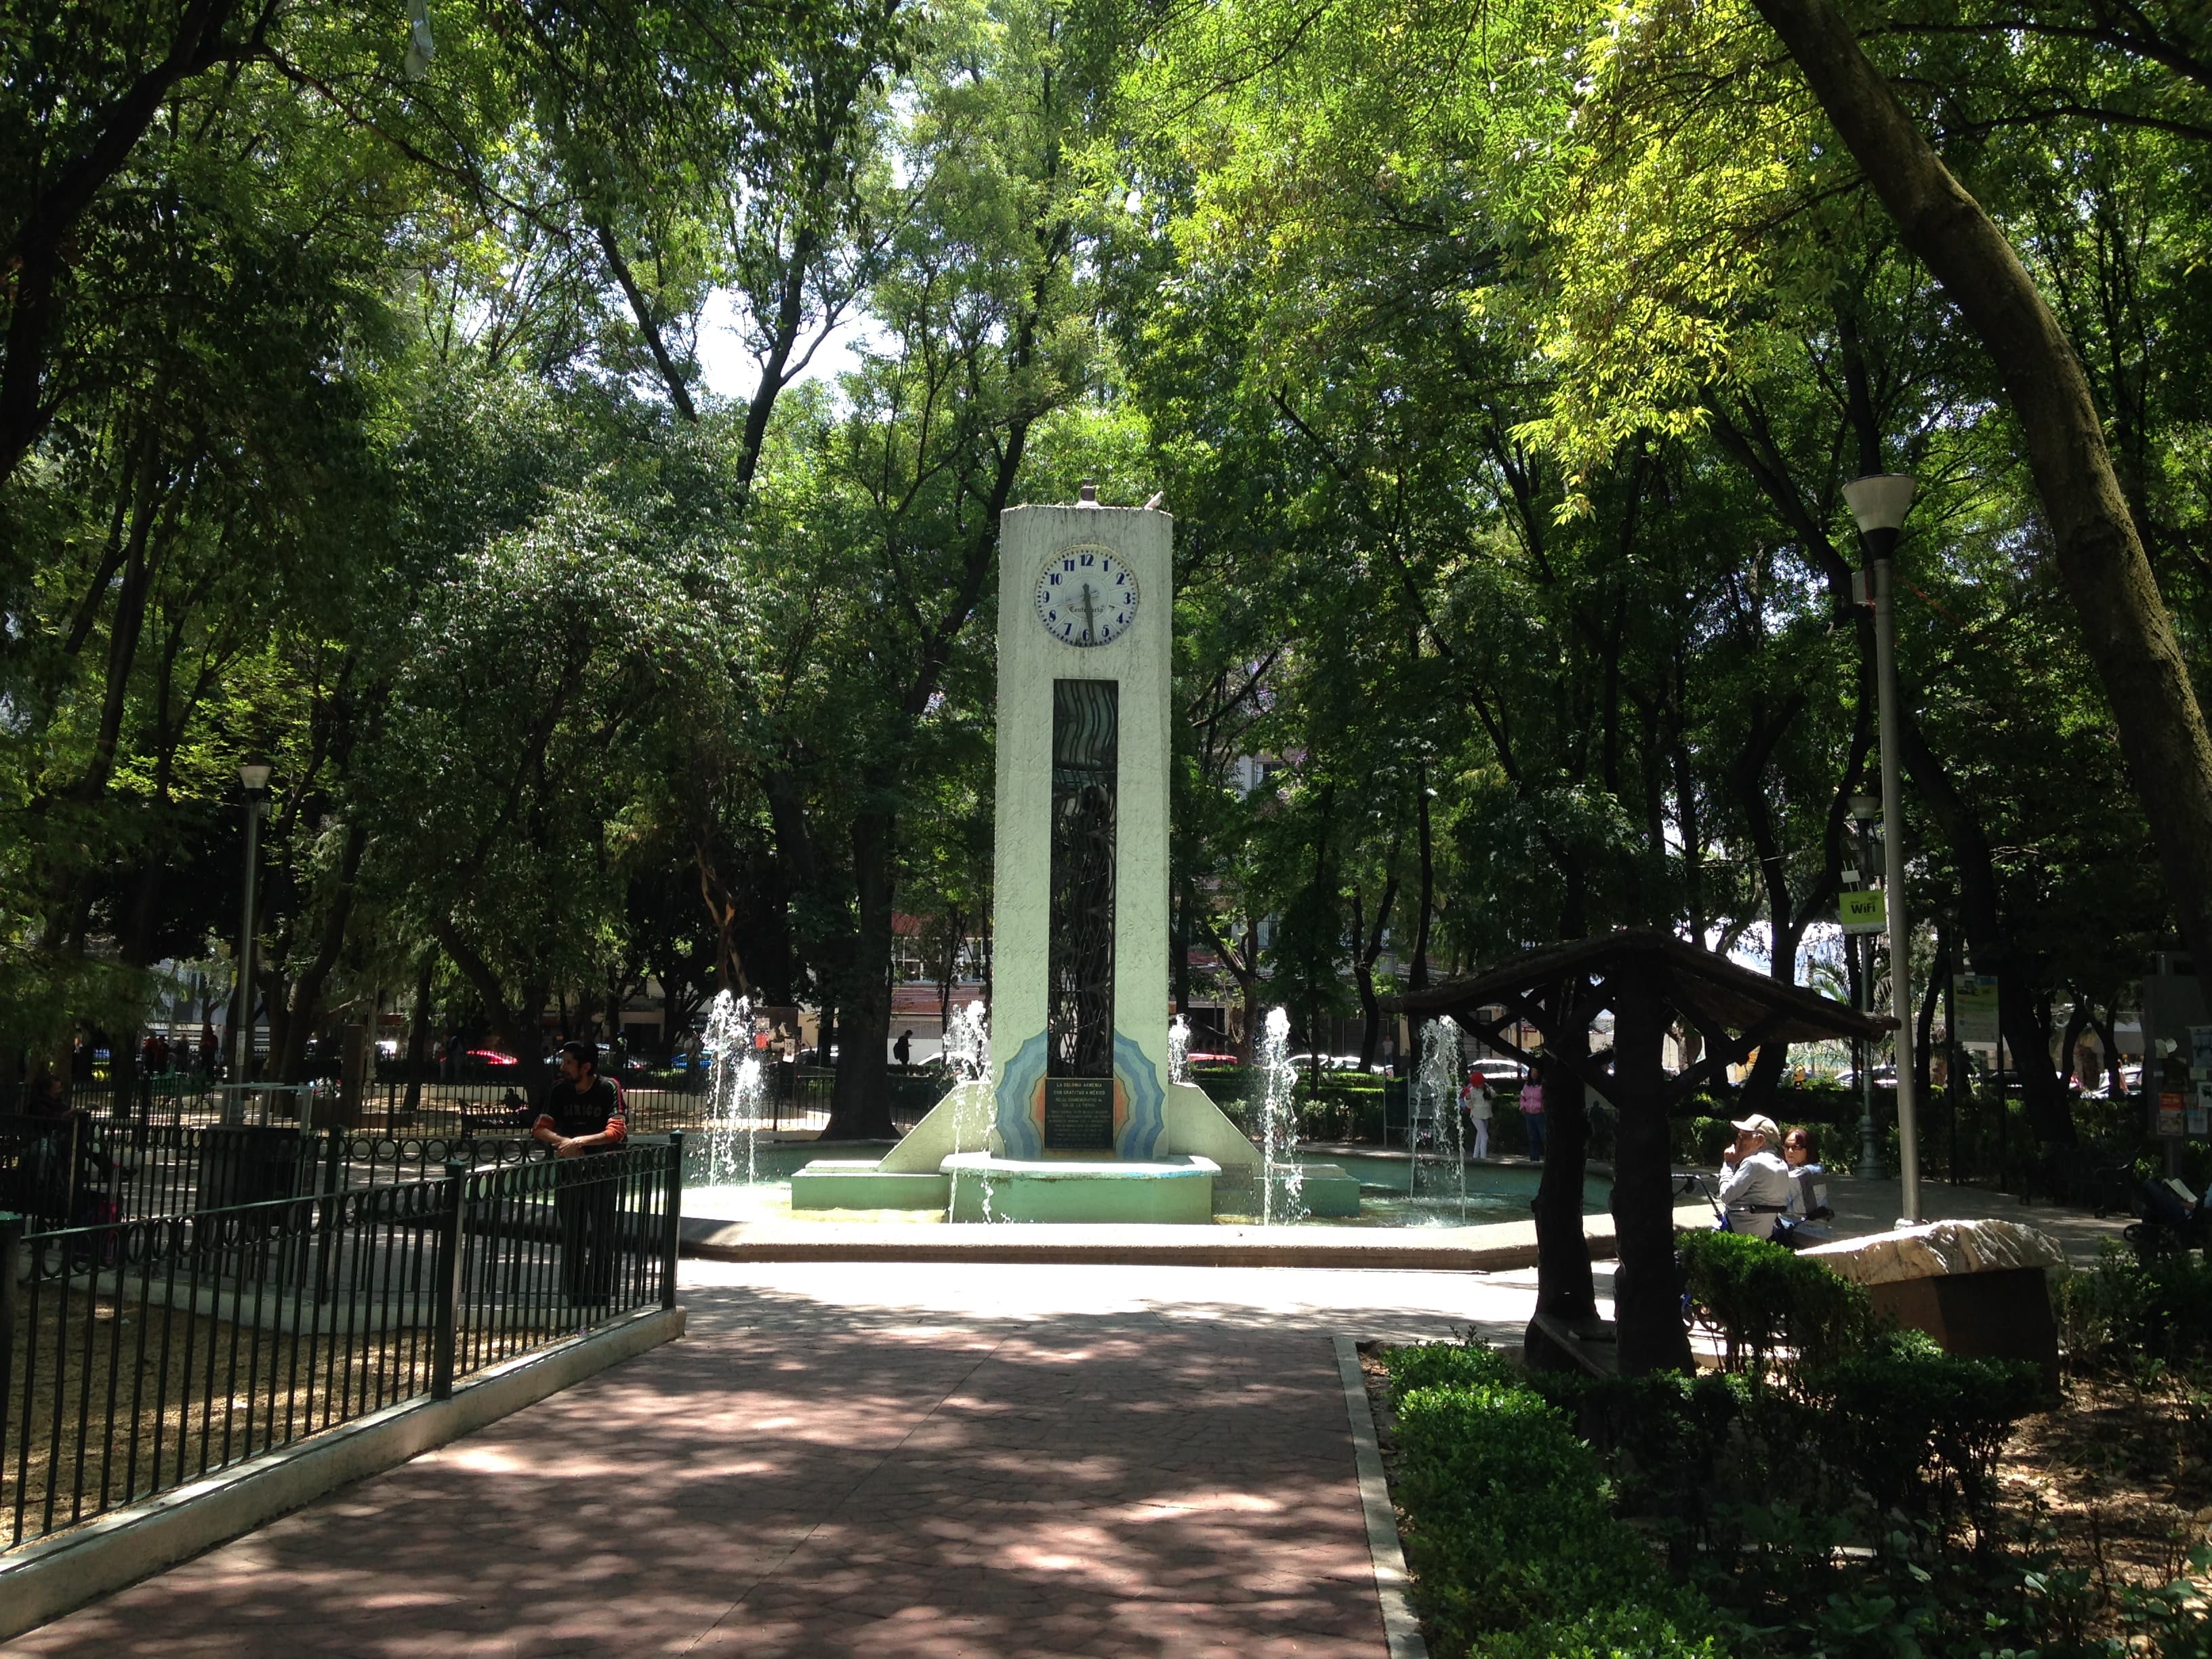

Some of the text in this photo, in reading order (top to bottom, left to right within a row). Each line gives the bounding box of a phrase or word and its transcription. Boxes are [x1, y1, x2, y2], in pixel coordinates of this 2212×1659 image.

[1063, 559, 1075, 571] 11
[1080, 554, 1094, 567] 12
[1102, 560, 1109, 572] 1
[1049, 573, 1063, 586] 10
[1116, 573, 1125, 585] 2
[1042, 591, 1050, 603] 9
[1124, 592, 1131, 605] 3
[1048, 610, 1056, 622] 8
[1116, 612, 1124, 623] 4
[1064, 623, 1072, 636] 7
[1082, 629, 1090, 641] 6
[1102, 625, 1109, 637] 5
